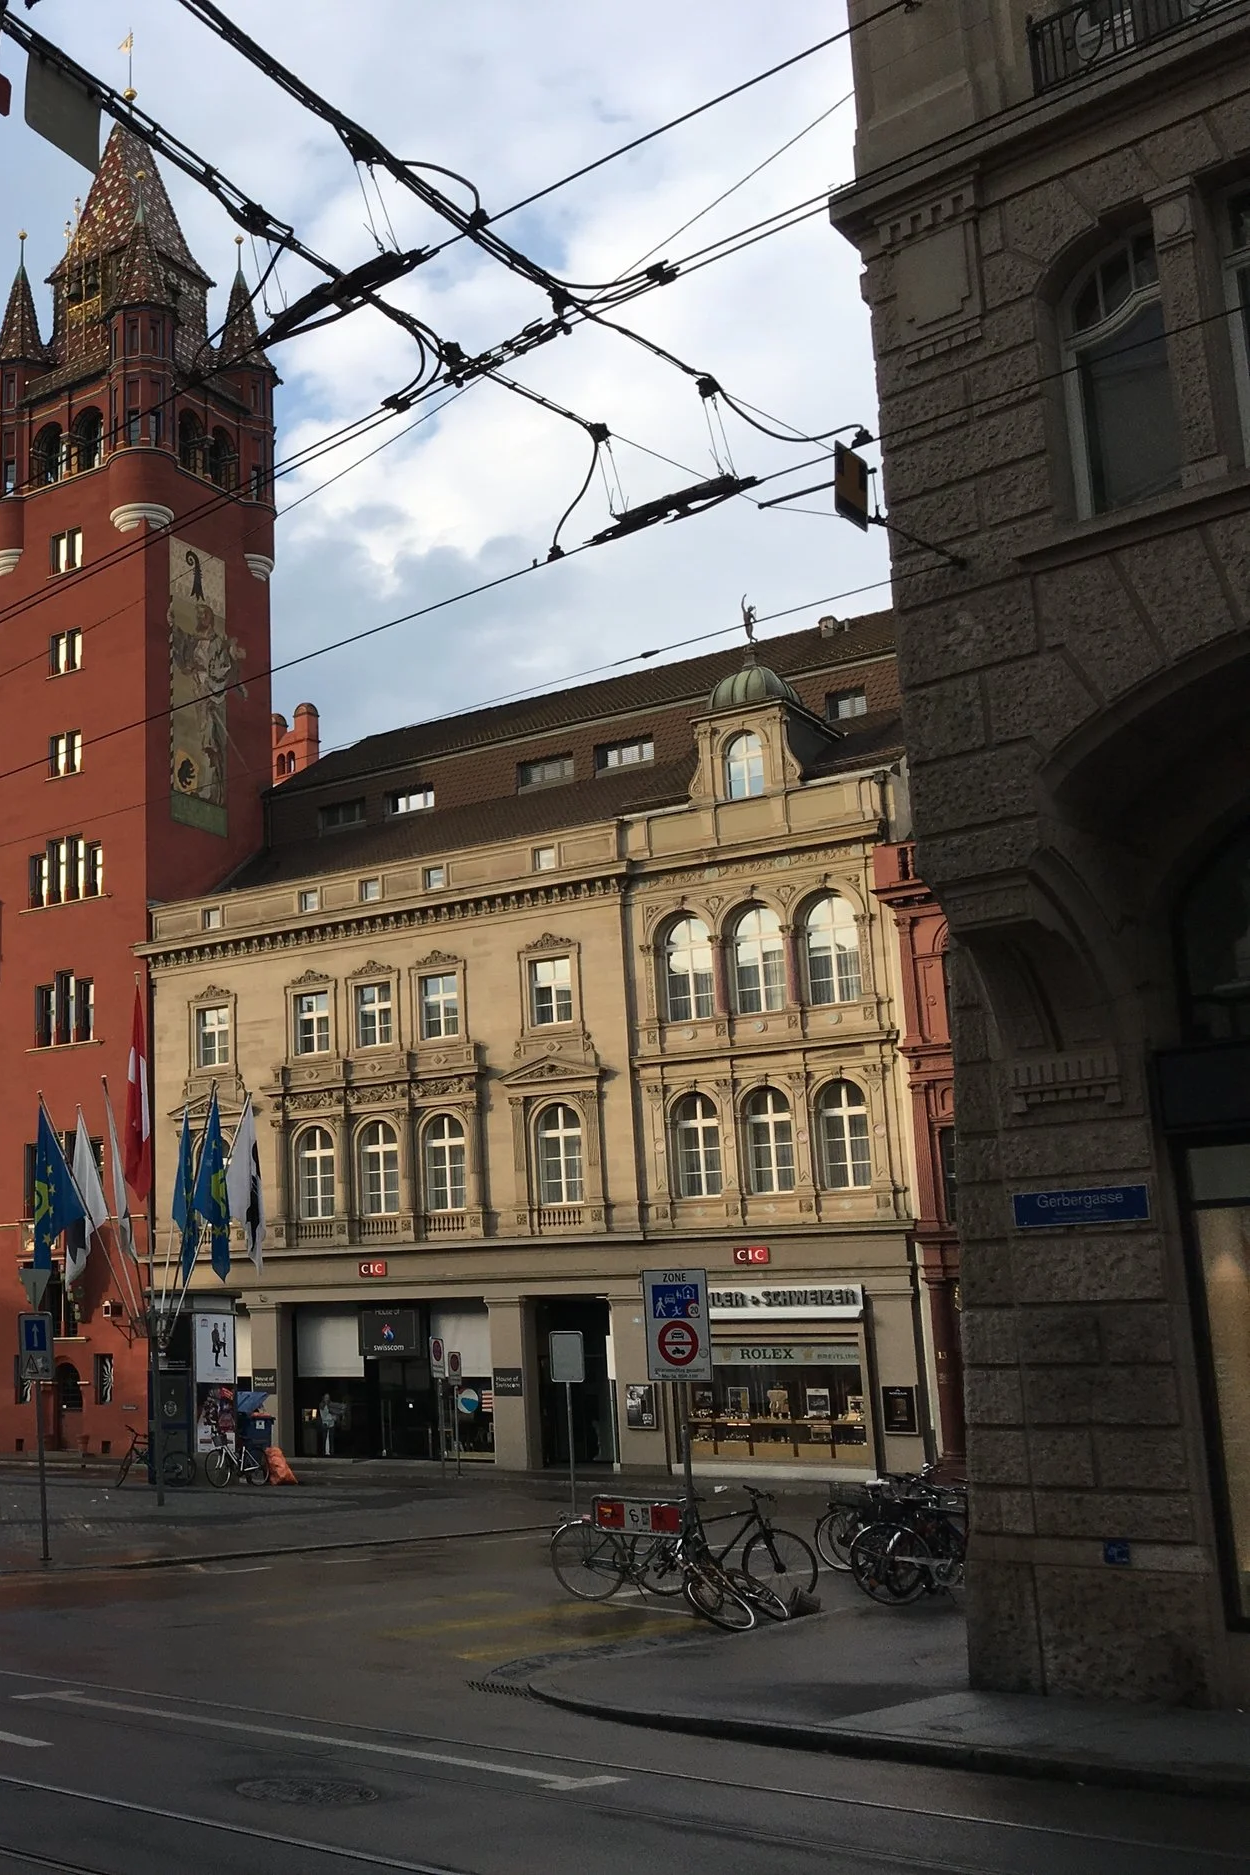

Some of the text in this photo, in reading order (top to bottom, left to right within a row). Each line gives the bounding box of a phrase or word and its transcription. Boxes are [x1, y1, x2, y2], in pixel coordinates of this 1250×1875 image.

[1036, 1192, 1124, 1208] Gerbergasse
[736, 1249, 765, 1261] CIC
[361, 1263, 383, 1275] CIC
[662, 1273, 686, 1282] ZONE
[761, 1289, 858, 1307] SCHWEIZER
[690, 1306, 699, 1314] 20
[740, 1348, 795, 1360] ROLEX
